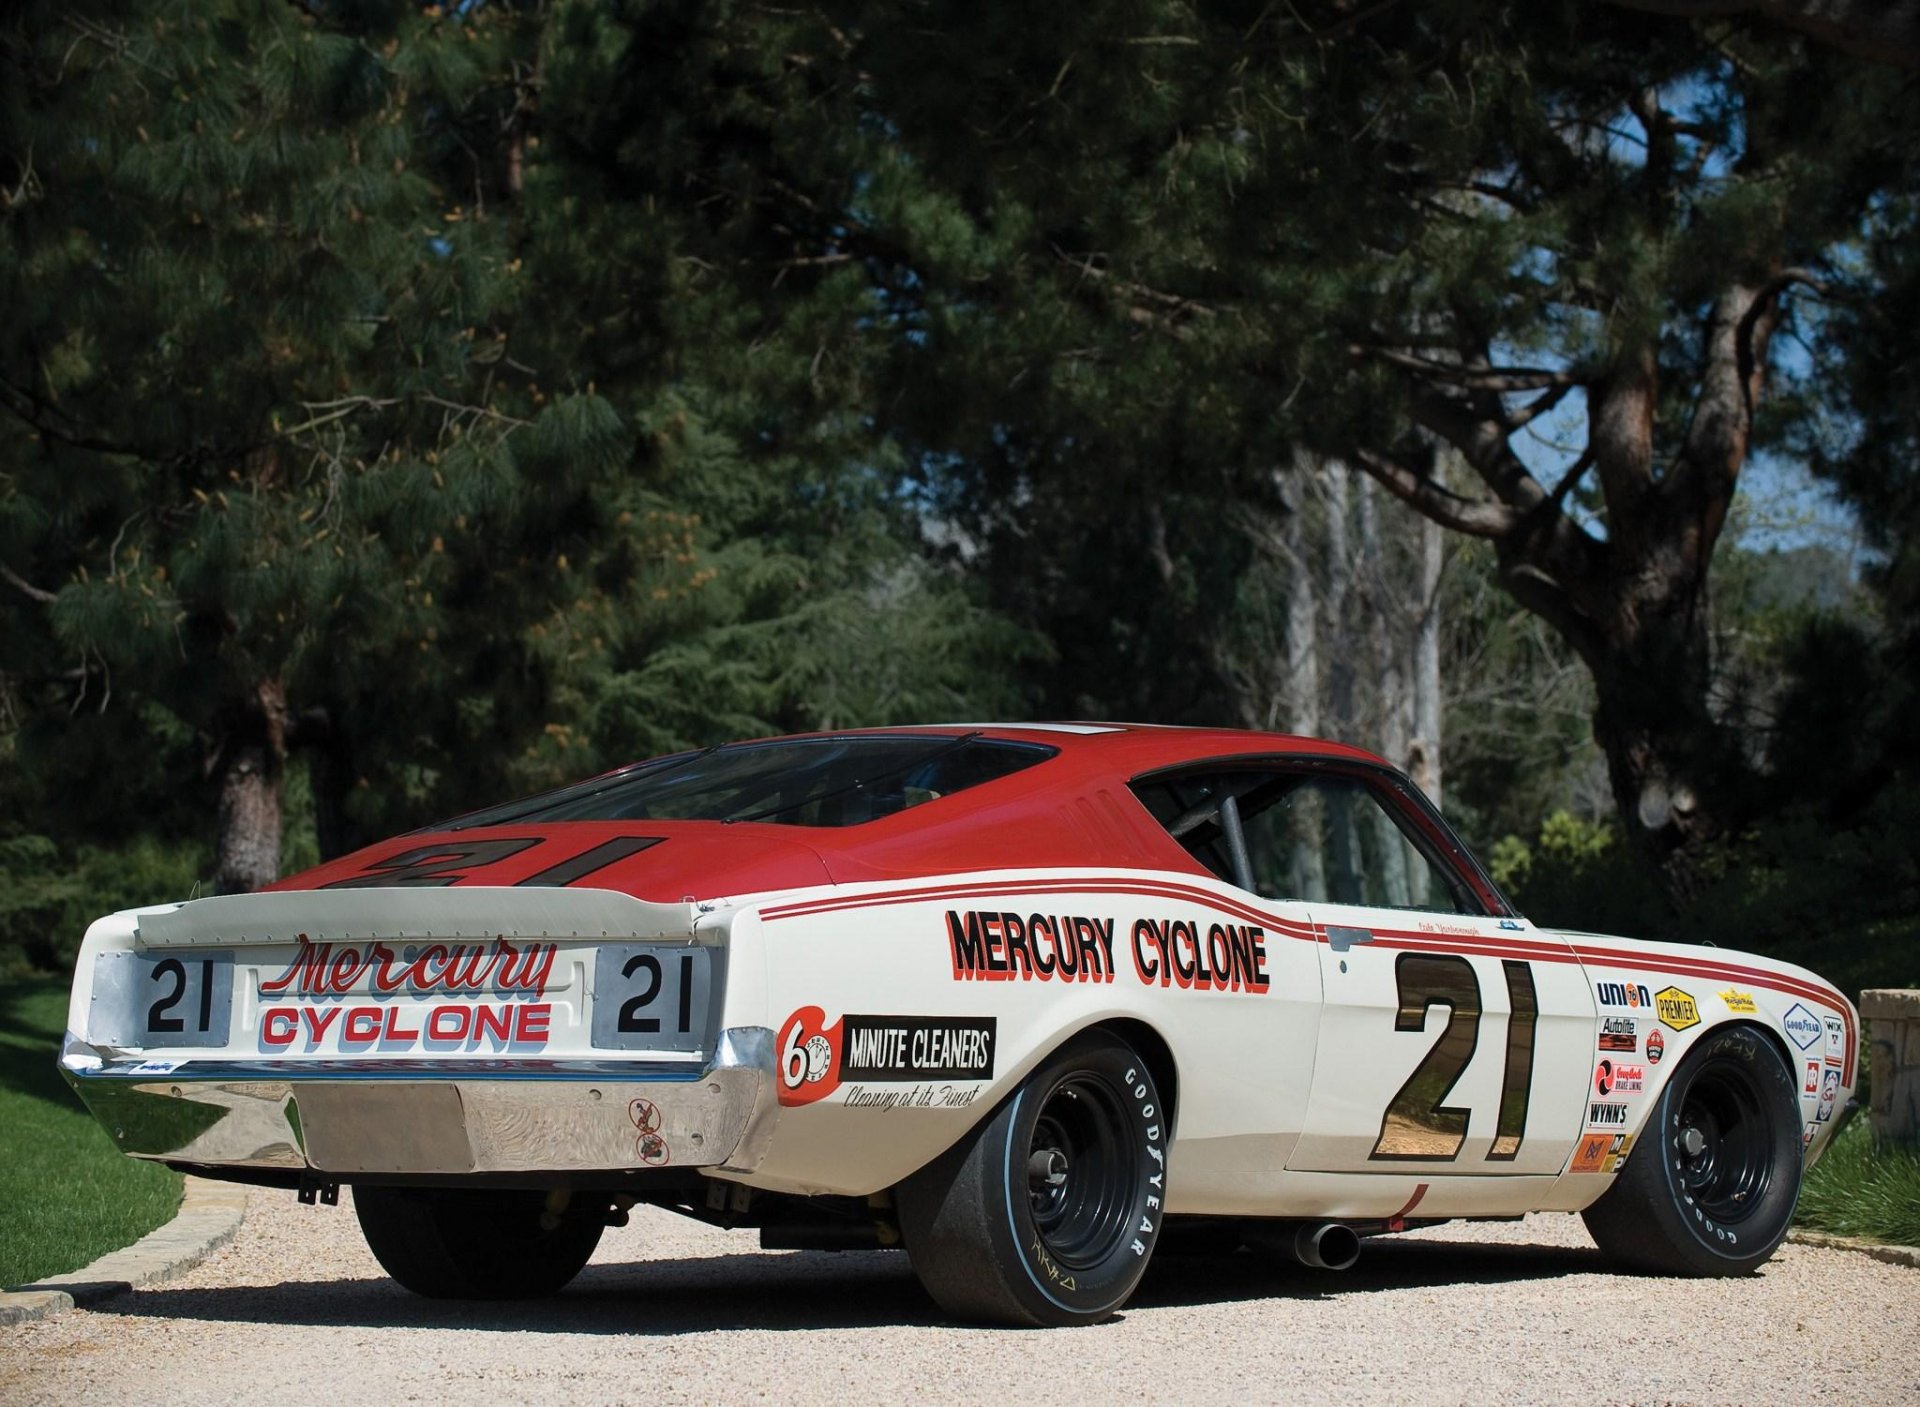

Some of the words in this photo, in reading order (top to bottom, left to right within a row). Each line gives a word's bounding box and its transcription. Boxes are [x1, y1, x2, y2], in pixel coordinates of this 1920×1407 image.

[257, 933, 559, 999] Mercury
[945, 910, 1115, 983] MERCURY
[1131, 918, 1271, 994] CYCLONE
[147, 957, 213, 1033] 21
[617, 953, 692, 1033] 21
[1658, 999, 1696, 1021] PREMIER
[258, 1003, 551, 1053] CYCLONE
[849, 1028, 908, 1069] MINUTE
[911, 1029, 990, 1069] CLEANERS
[1603, 1018, 1635, 1034] Autolite
[1825, 1020, 1842, 1033] WIX
[1367, 951, 1539, 1162] 21
[900, 1085, 918, 1107] at
[916, 1085, 935, 1108] its
[1589, 1103, 1628, 1124] WYNN'S
[1124, 1068, 1164, 1257] GOODYEAR
